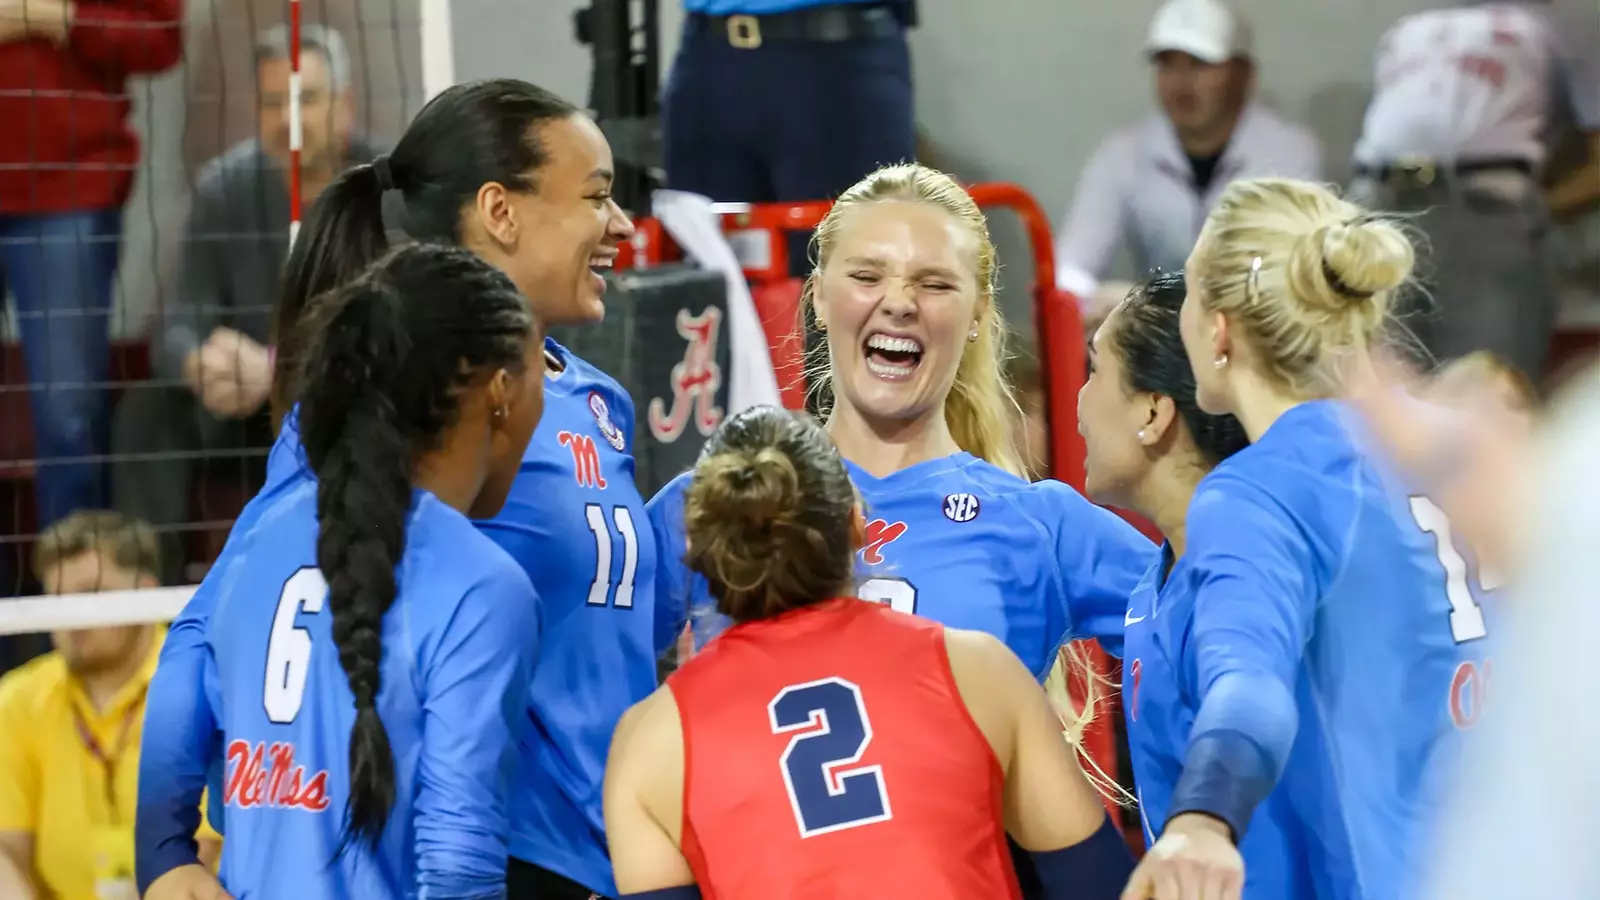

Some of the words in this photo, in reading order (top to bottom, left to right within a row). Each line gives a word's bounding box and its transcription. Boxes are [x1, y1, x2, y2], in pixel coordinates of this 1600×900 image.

[585, 503, 639, 611] 11
[943, 493, 979, 522] SEC
[263, 565, 329, 725] 6
[224, 739, 267, 808] Ole
[767, 676, 893, 839] 2
